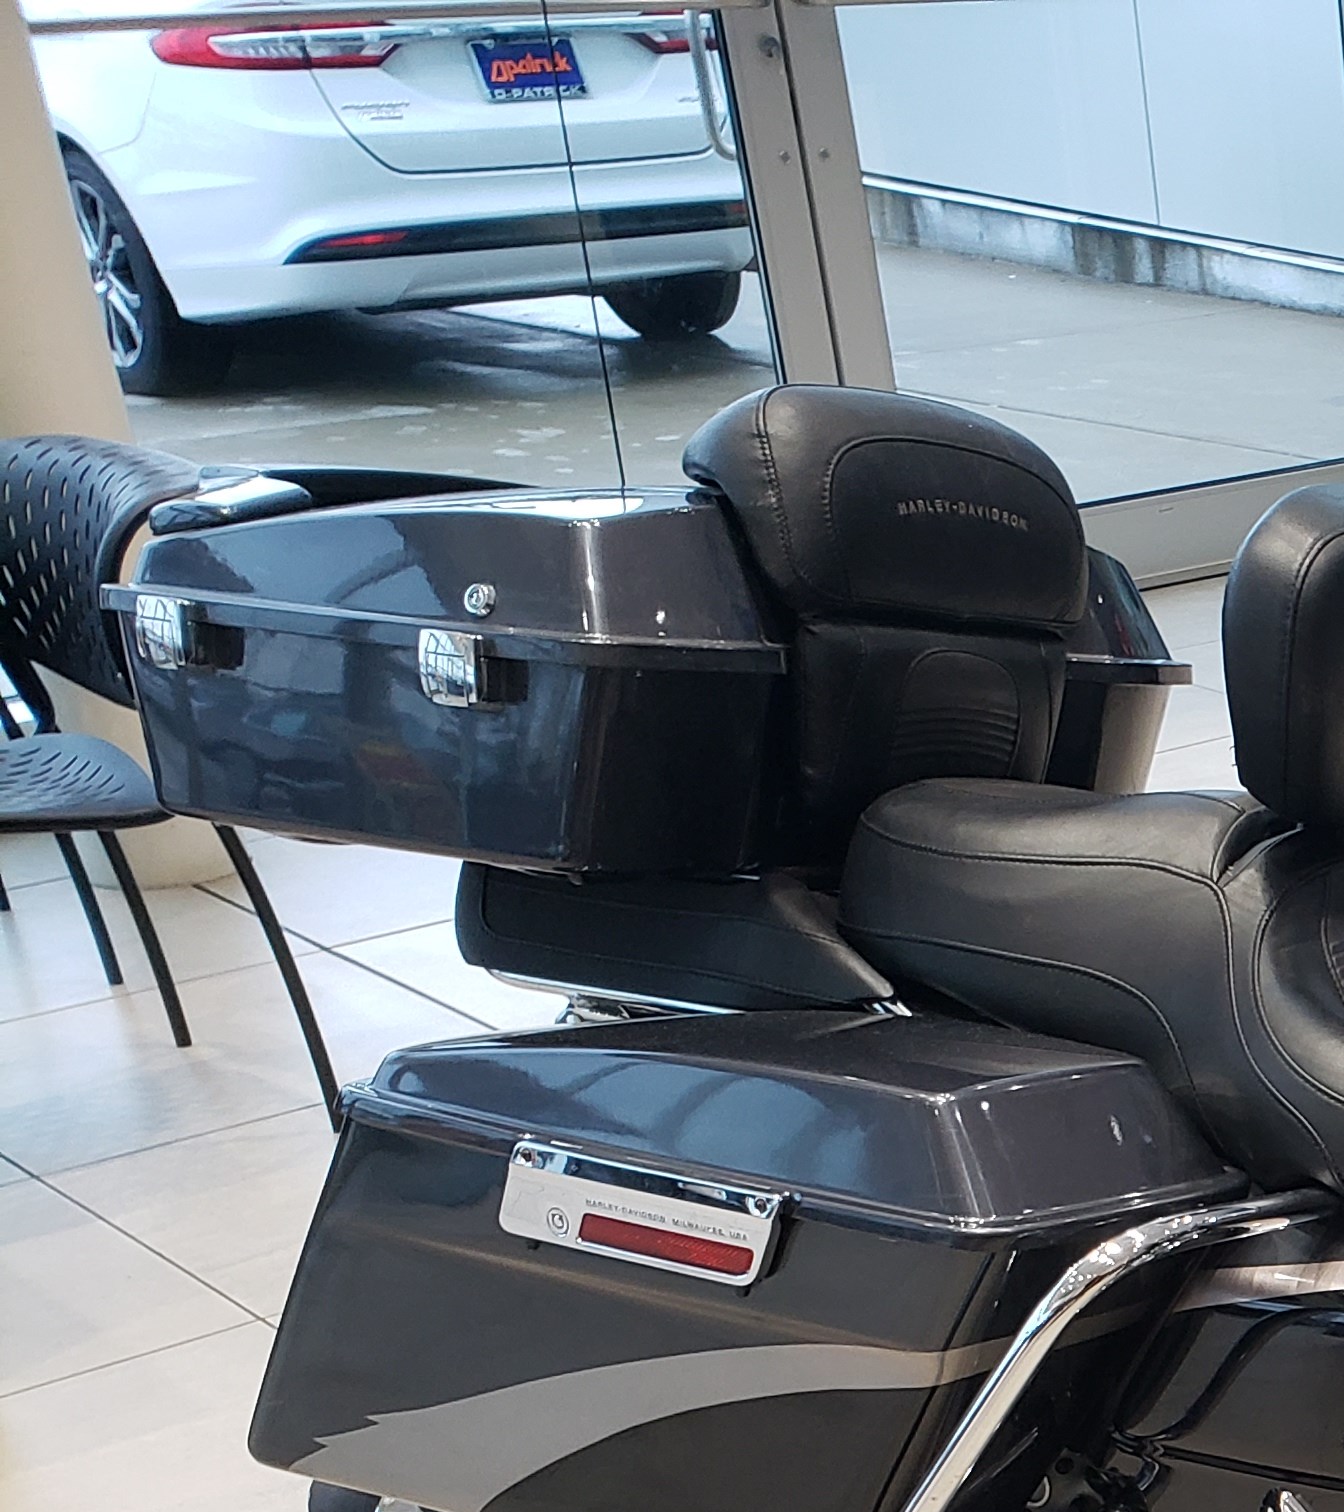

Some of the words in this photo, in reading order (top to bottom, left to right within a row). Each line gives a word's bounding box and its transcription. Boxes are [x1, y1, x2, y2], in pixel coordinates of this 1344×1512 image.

[493, 85, 582, 100] D-PATRCK
[897, 499, 1029, 532] HARLEY-DAVIDSON
[585, 1197, 666, 1225] HARLEY-DAVIDSON
